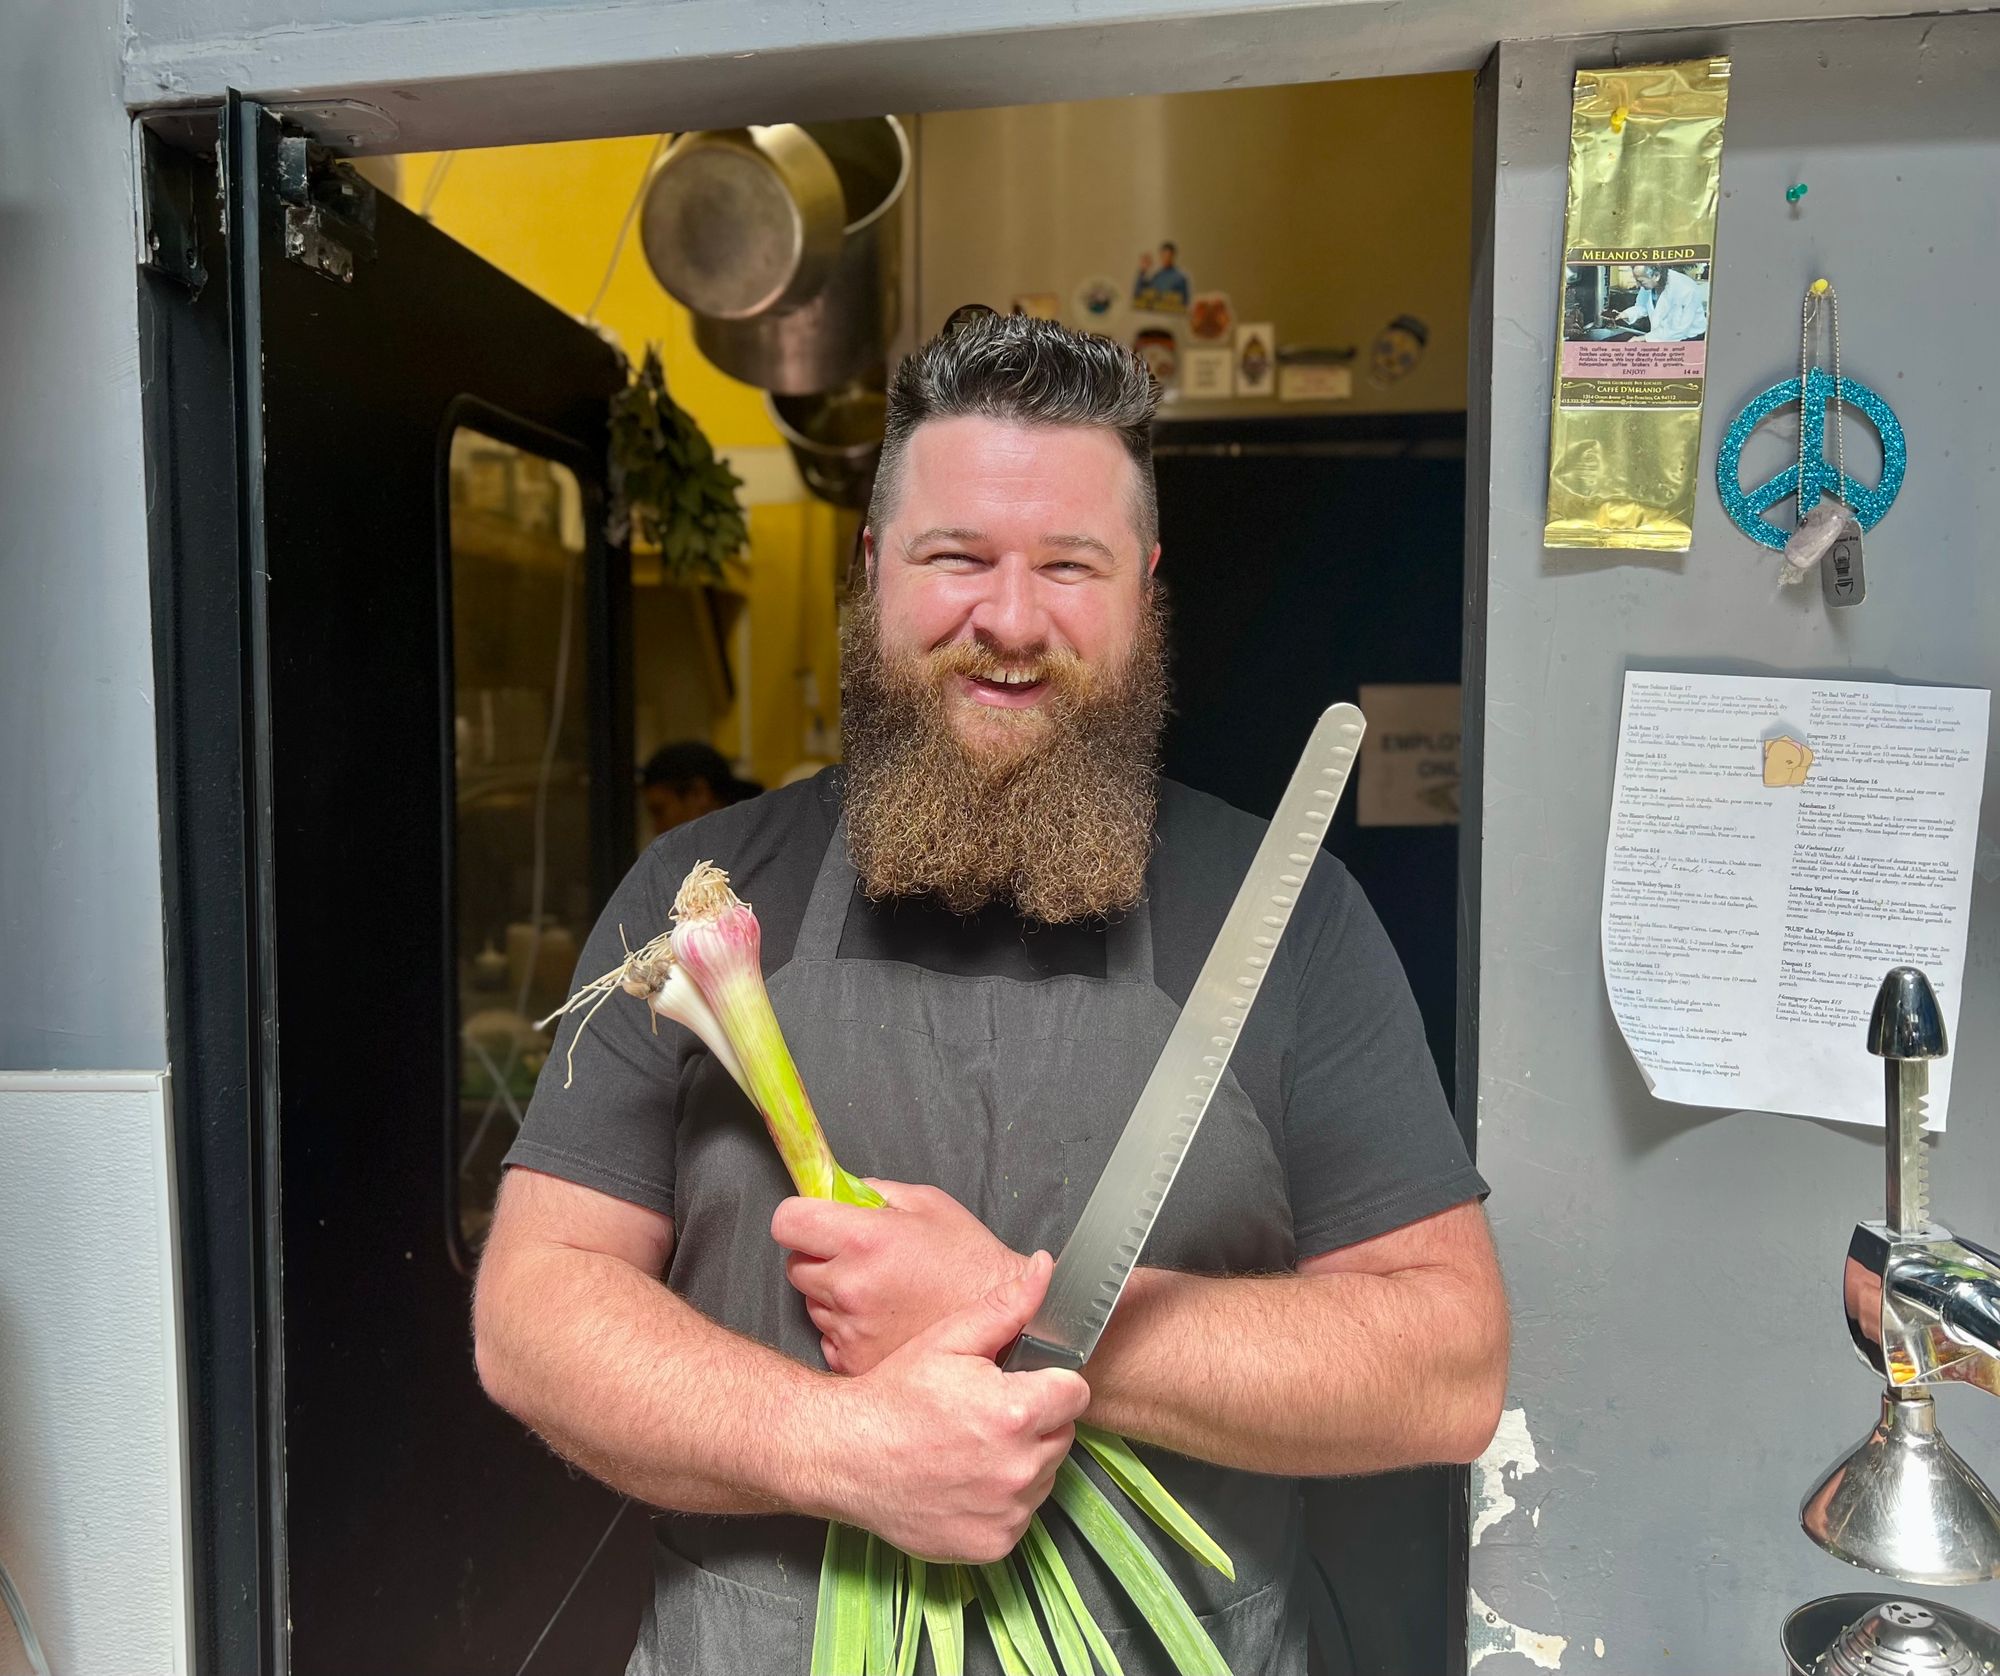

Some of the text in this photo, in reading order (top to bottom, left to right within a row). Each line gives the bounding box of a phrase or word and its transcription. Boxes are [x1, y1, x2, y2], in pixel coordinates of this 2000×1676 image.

[1582, 249, 1695, 260] MELANIO'S BLEND
[1381, 733, 1461, 752] EMPLO
[1799, 802, 1826, 810] Manhattan
[1814, 886, 1837, 896] Whiskey
[1814, 928, 1826, 936] Day
